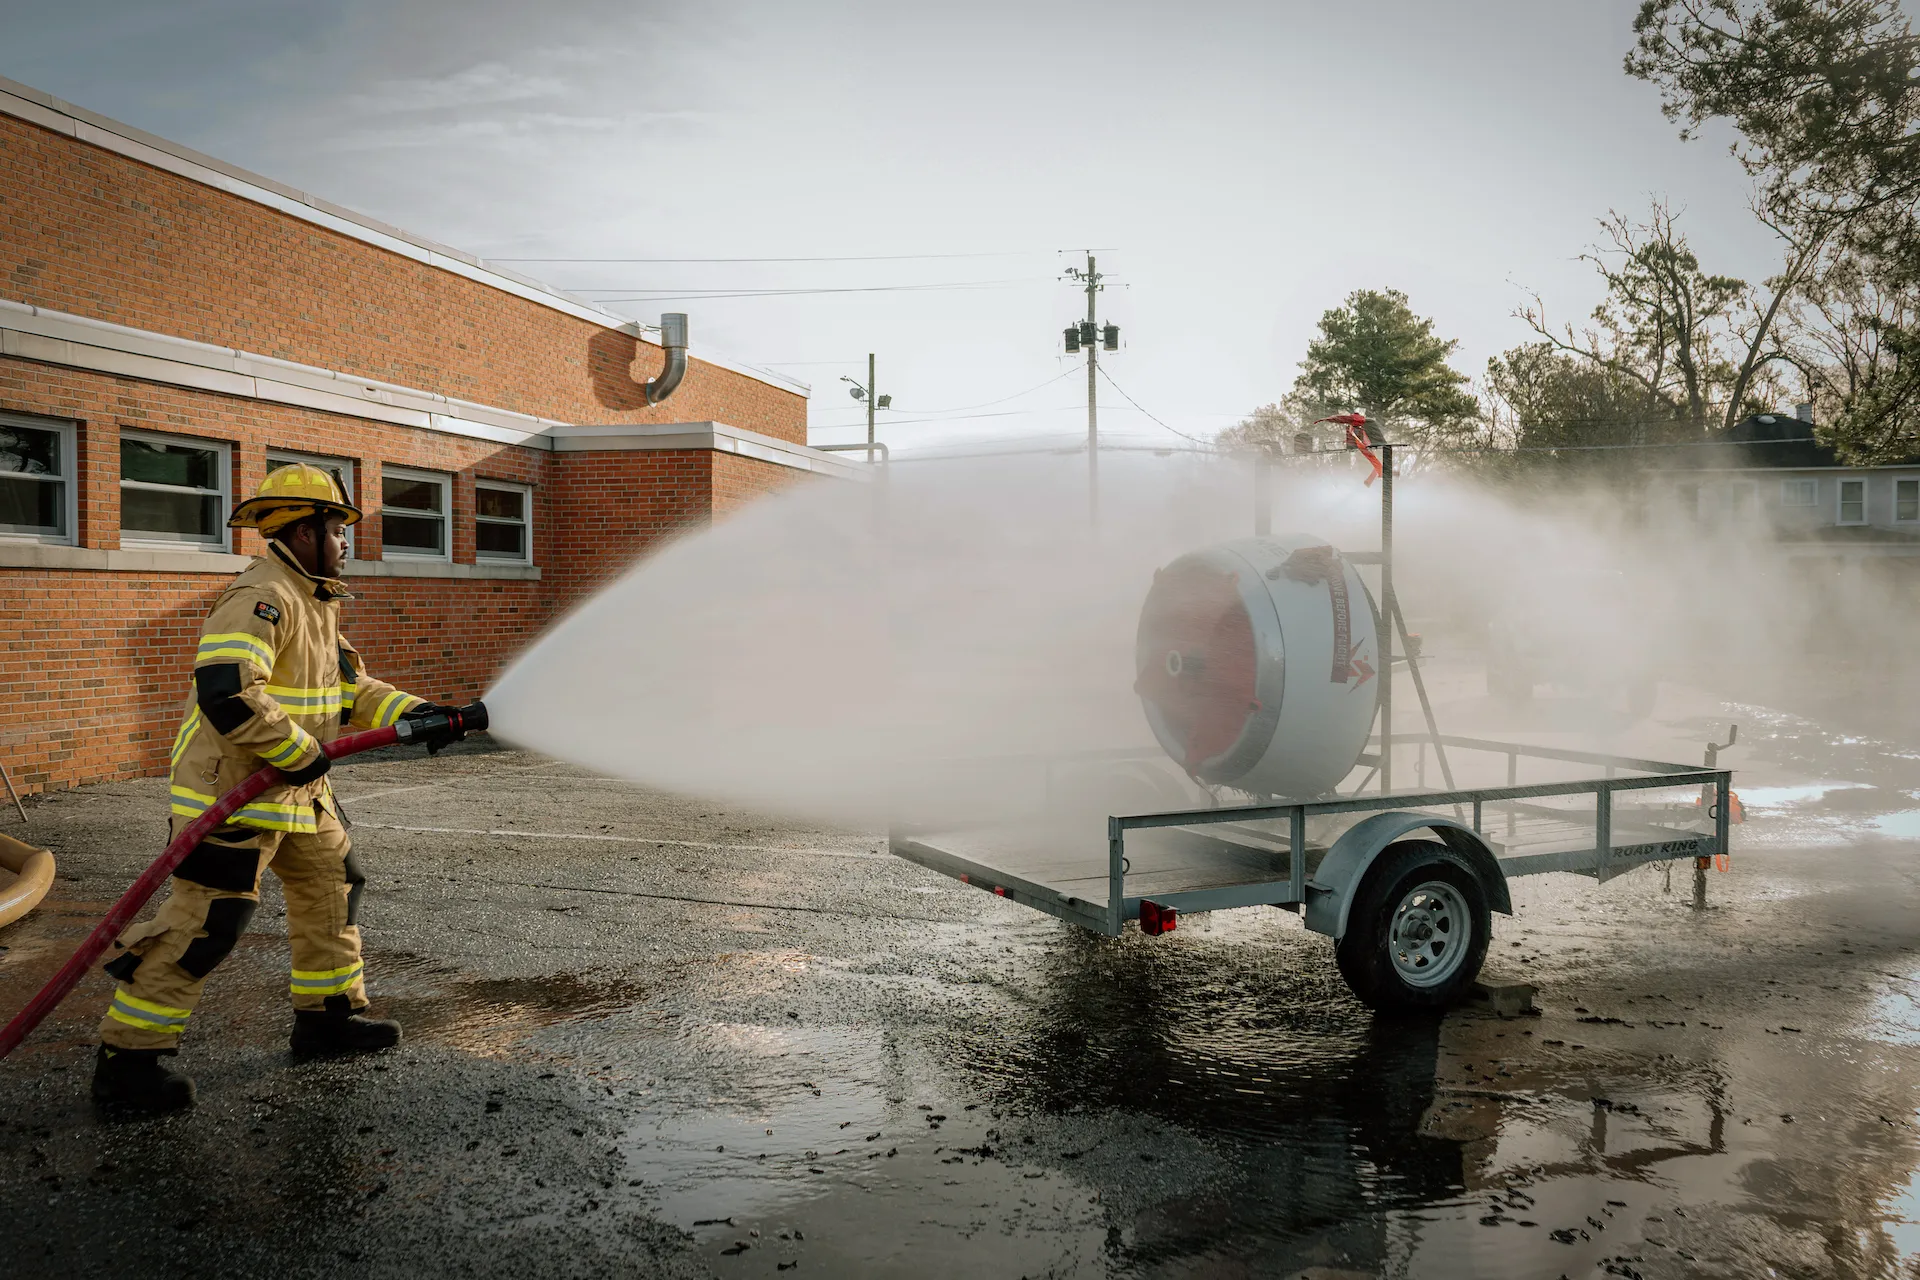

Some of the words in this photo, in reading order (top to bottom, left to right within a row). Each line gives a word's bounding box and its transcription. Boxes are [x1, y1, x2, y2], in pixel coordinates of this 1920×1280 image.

[1335, 598, 1348, 632] BEFORE
[1335, 634, 1347, 668] FLIGHT
[1612, 845, 1654, 858] ROAD
[1660, 840, 1698, 853] KING
